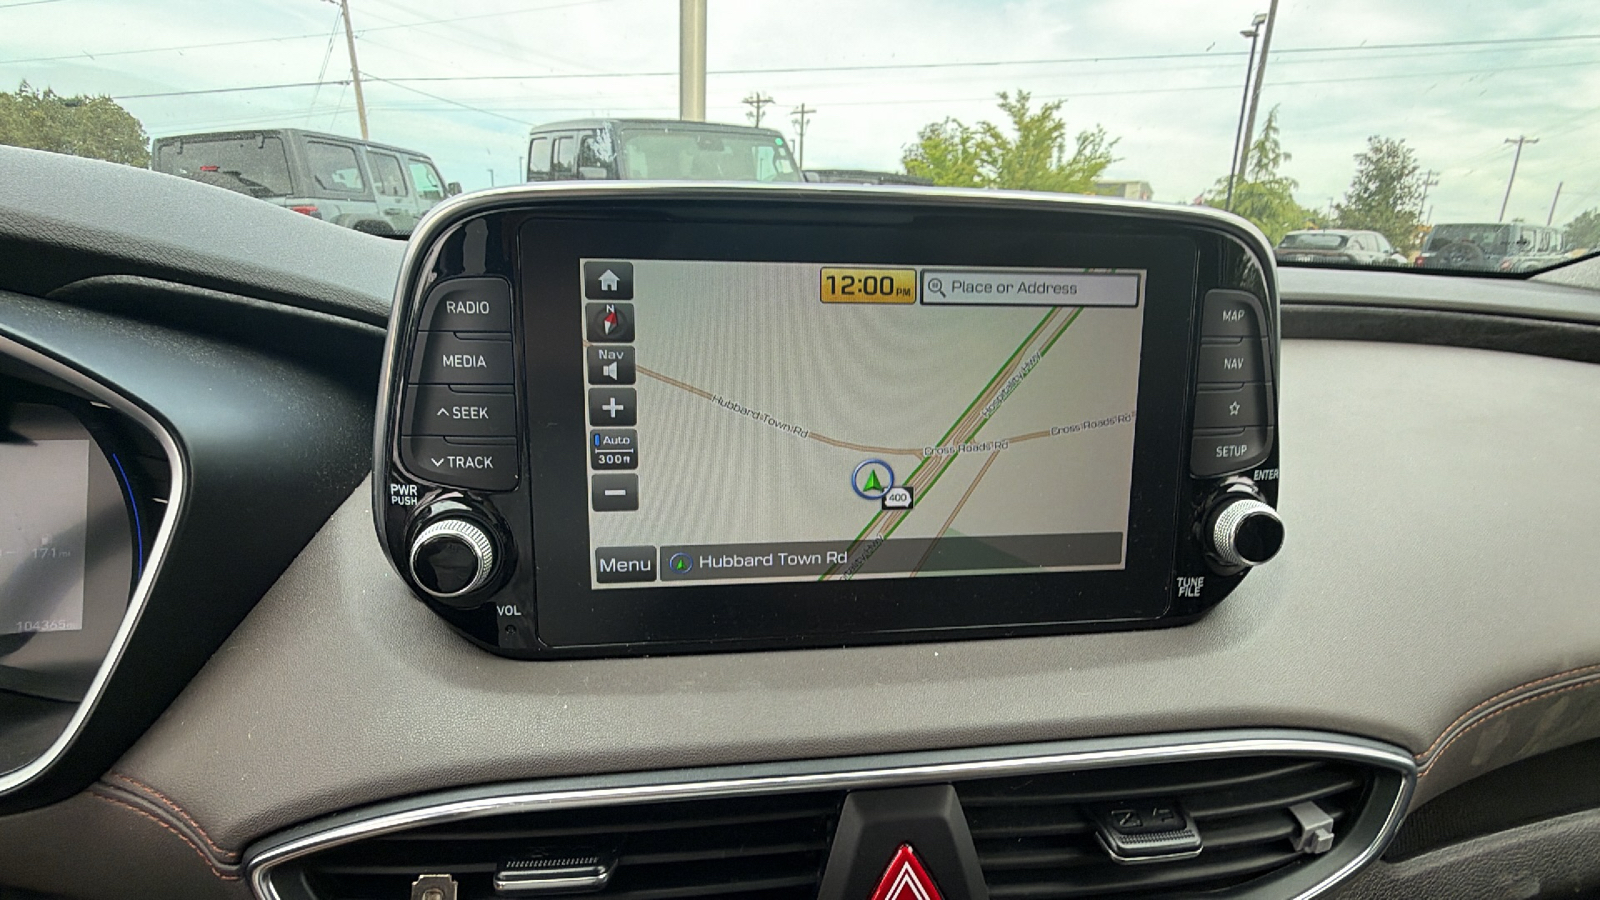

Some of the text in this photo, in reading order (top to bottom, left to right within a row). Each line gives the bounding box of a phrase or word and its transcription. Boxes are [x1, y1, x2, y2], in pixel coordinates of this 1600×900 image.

[951, 280, 1078, 295] Place or Address
[446, 301, 490, 314] RADIO
[606, 304, 615, 313] N
[1222, 309, 1245, 322] MAP
[598, 350, 624, 360] Nav
[442, 355, 487, 368] MEDIA
[1223, 358, 1244, 370] NAV
[982, 371, 1024, 417] Hospitality
[452, 407, 489, 419] SEEK
[711, 394, 809, 439] Hubbard Town Rd
[1051, 413, 1131, 436] Cross Roads Rd
[602, 436, 631, 445] Auto
[924, 440, 1009, 456] Cross Roads Rd
[1216, 444, 1247, 457] SETUP
[447, 456, 494, 469] TRACK
[1253, 469, 1279, 481] ENTER
[390, 484, 418, 496] PWR
[391, 496, 418, 506] PUSH
[889, 493, 908, 502] 400
[599, 557, 651, 572] Menu
[700, 550, 848, 569] Hubbard Town Rd
[1177, 576, 1204, 587] TUNE
[1178, 586, 1201, 598] FILE
[496, 605, 522, 616] VOL
